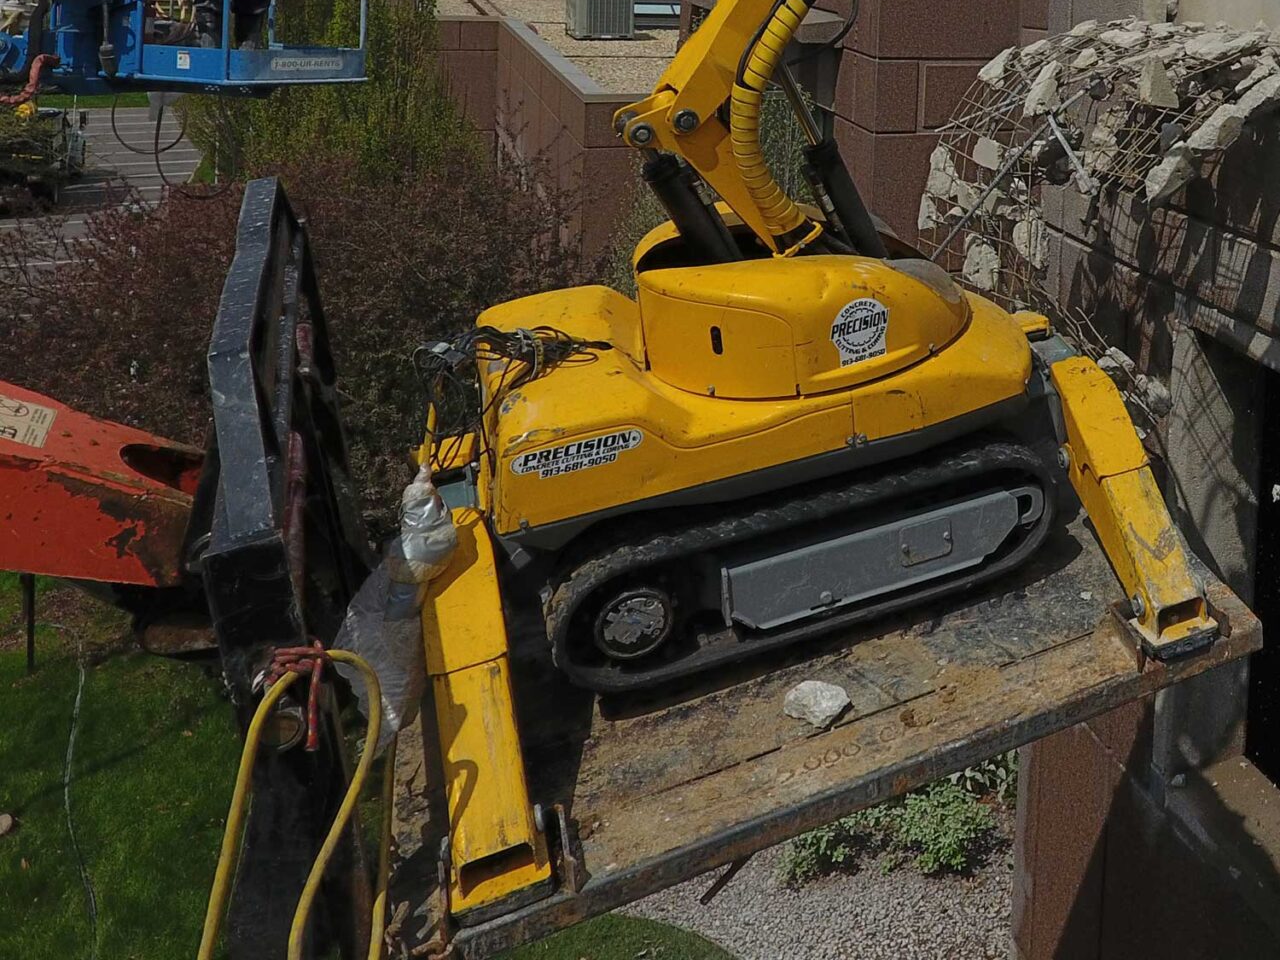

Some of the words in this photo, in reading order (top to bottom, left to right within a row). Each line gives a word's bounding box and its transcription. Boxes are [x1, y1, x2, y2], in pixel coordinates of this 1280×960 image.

[831, 309, 889, 339] PRECISION
[841, 301, 877, 318] CONCRETE
[835, 339, 860, 355] CUTTING
[867, 326, 886, 349] CORING
[841, 348, 886, 367] 913-681-9050
[521, 459, 560, 473] CONCRETE
[561, 452, 593, 464] CUTTING
[602, 443, 630, 454] CORING
[522, 431, 632, 467] PRECISION
[541, 453, 617, 478] 913-681-9050
